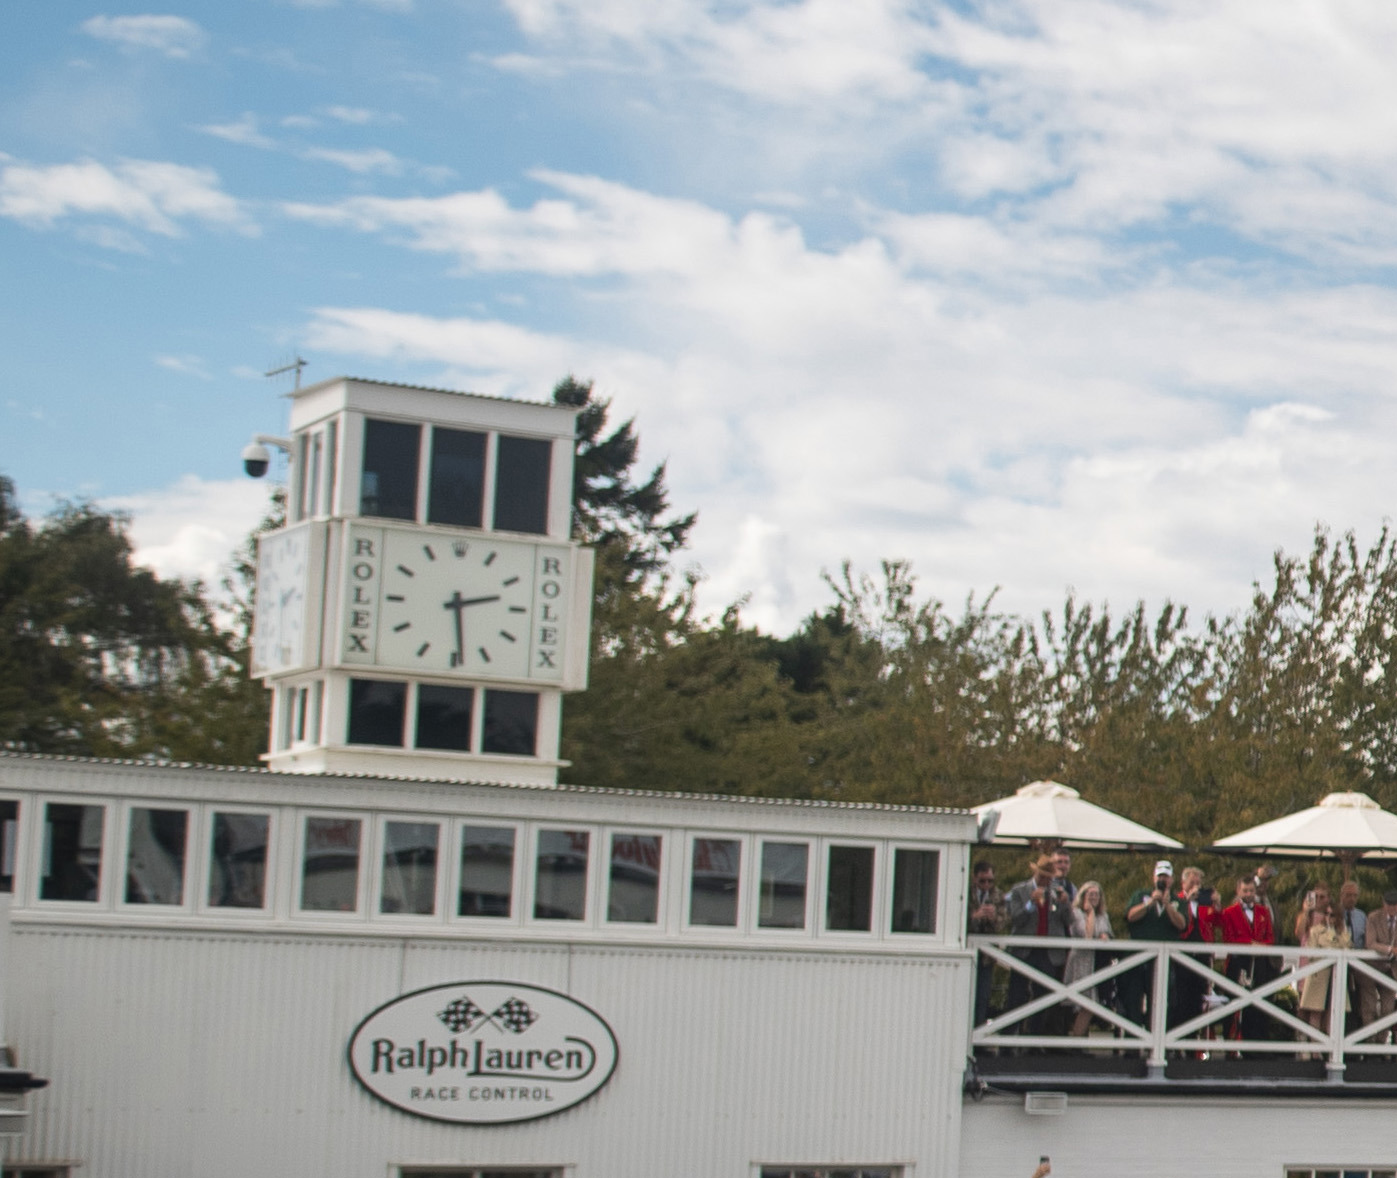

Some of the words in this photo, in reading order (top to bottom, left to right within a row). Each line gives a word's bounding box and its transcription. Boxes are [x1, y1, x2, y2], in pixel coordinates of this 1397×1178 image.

[349, 537, 374, 653] ROLEX
[536, 556, 562, 668] ROLEX
[372, 1038, 468, 1076] Ralph
[466, 1037, 596, 1082] Lauren
[410, 1086, 460, 1101] RACE
[469, 1086, 553, 1101] CONTROL
